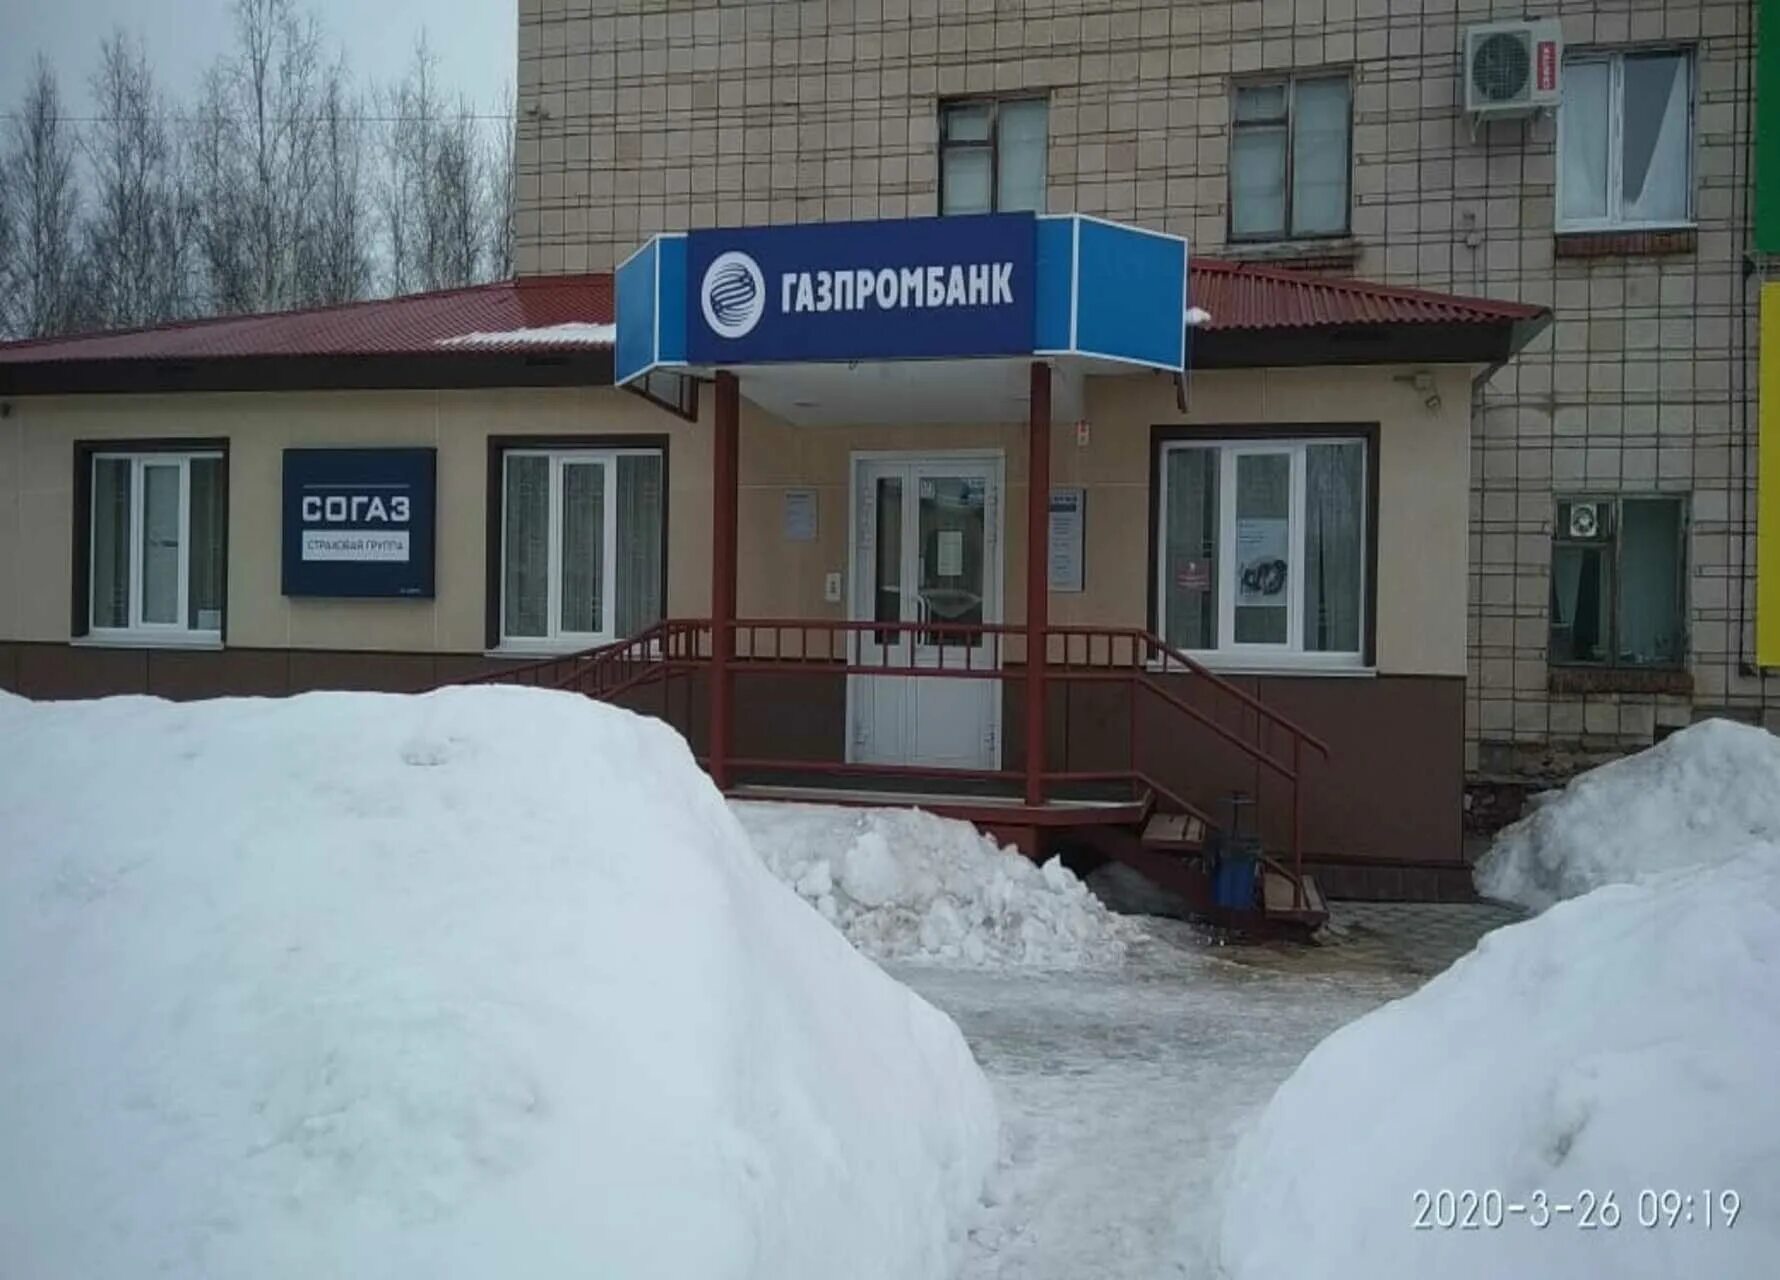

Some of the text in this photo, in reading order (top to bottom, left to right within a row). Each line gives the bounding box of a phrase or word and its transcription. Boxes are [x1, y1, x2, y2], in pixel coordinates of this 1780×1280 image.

[781, 262, 1014, 313] ГАЗПРОМБАНК
[302, 496, 410, 522] СОГАЗ
[366, 539, 403, 551] ГРУППА
